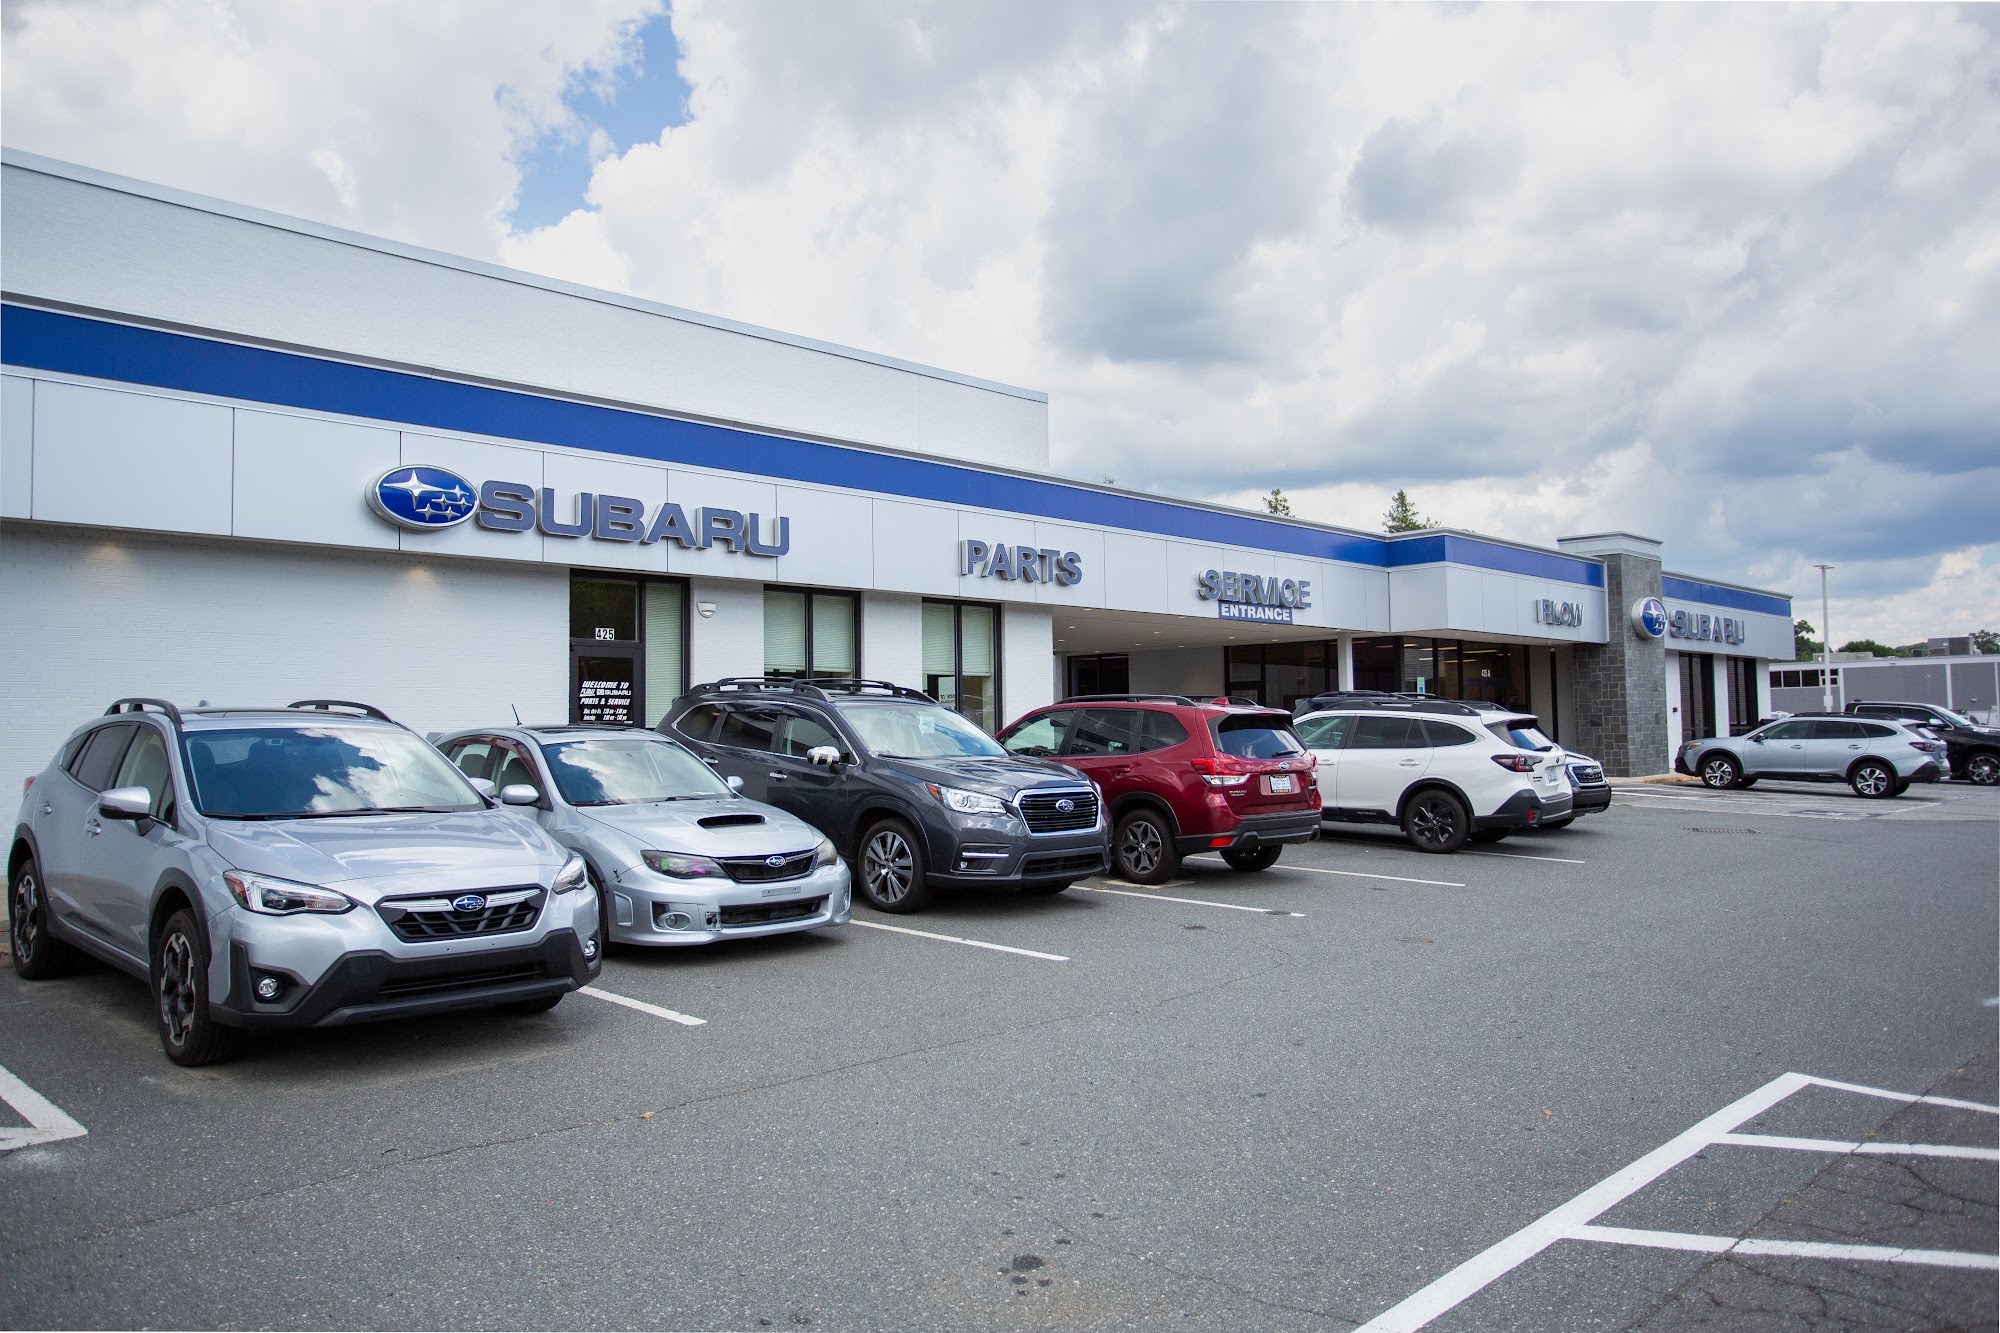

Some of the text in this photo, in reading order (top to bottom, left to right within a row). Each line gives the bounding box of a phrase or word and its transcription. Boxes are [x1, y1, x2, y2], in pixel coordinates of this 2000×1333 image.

[476, 480, 790, 557] SUBARU
[961, 539, 1083, 586] PARTS
[1198, 569, 1312, 609] SERVICE
[1221, 604, 1291, 620] ENTRANCE
[1536, 598, 1584, 627] FLOW
[597, 628, 614, 640] 425
[1669, 610, 1745, 645] SUBARU
[582, 681, 618, 689] WELCOME
[607, 698, 631, 706] SERVICE
